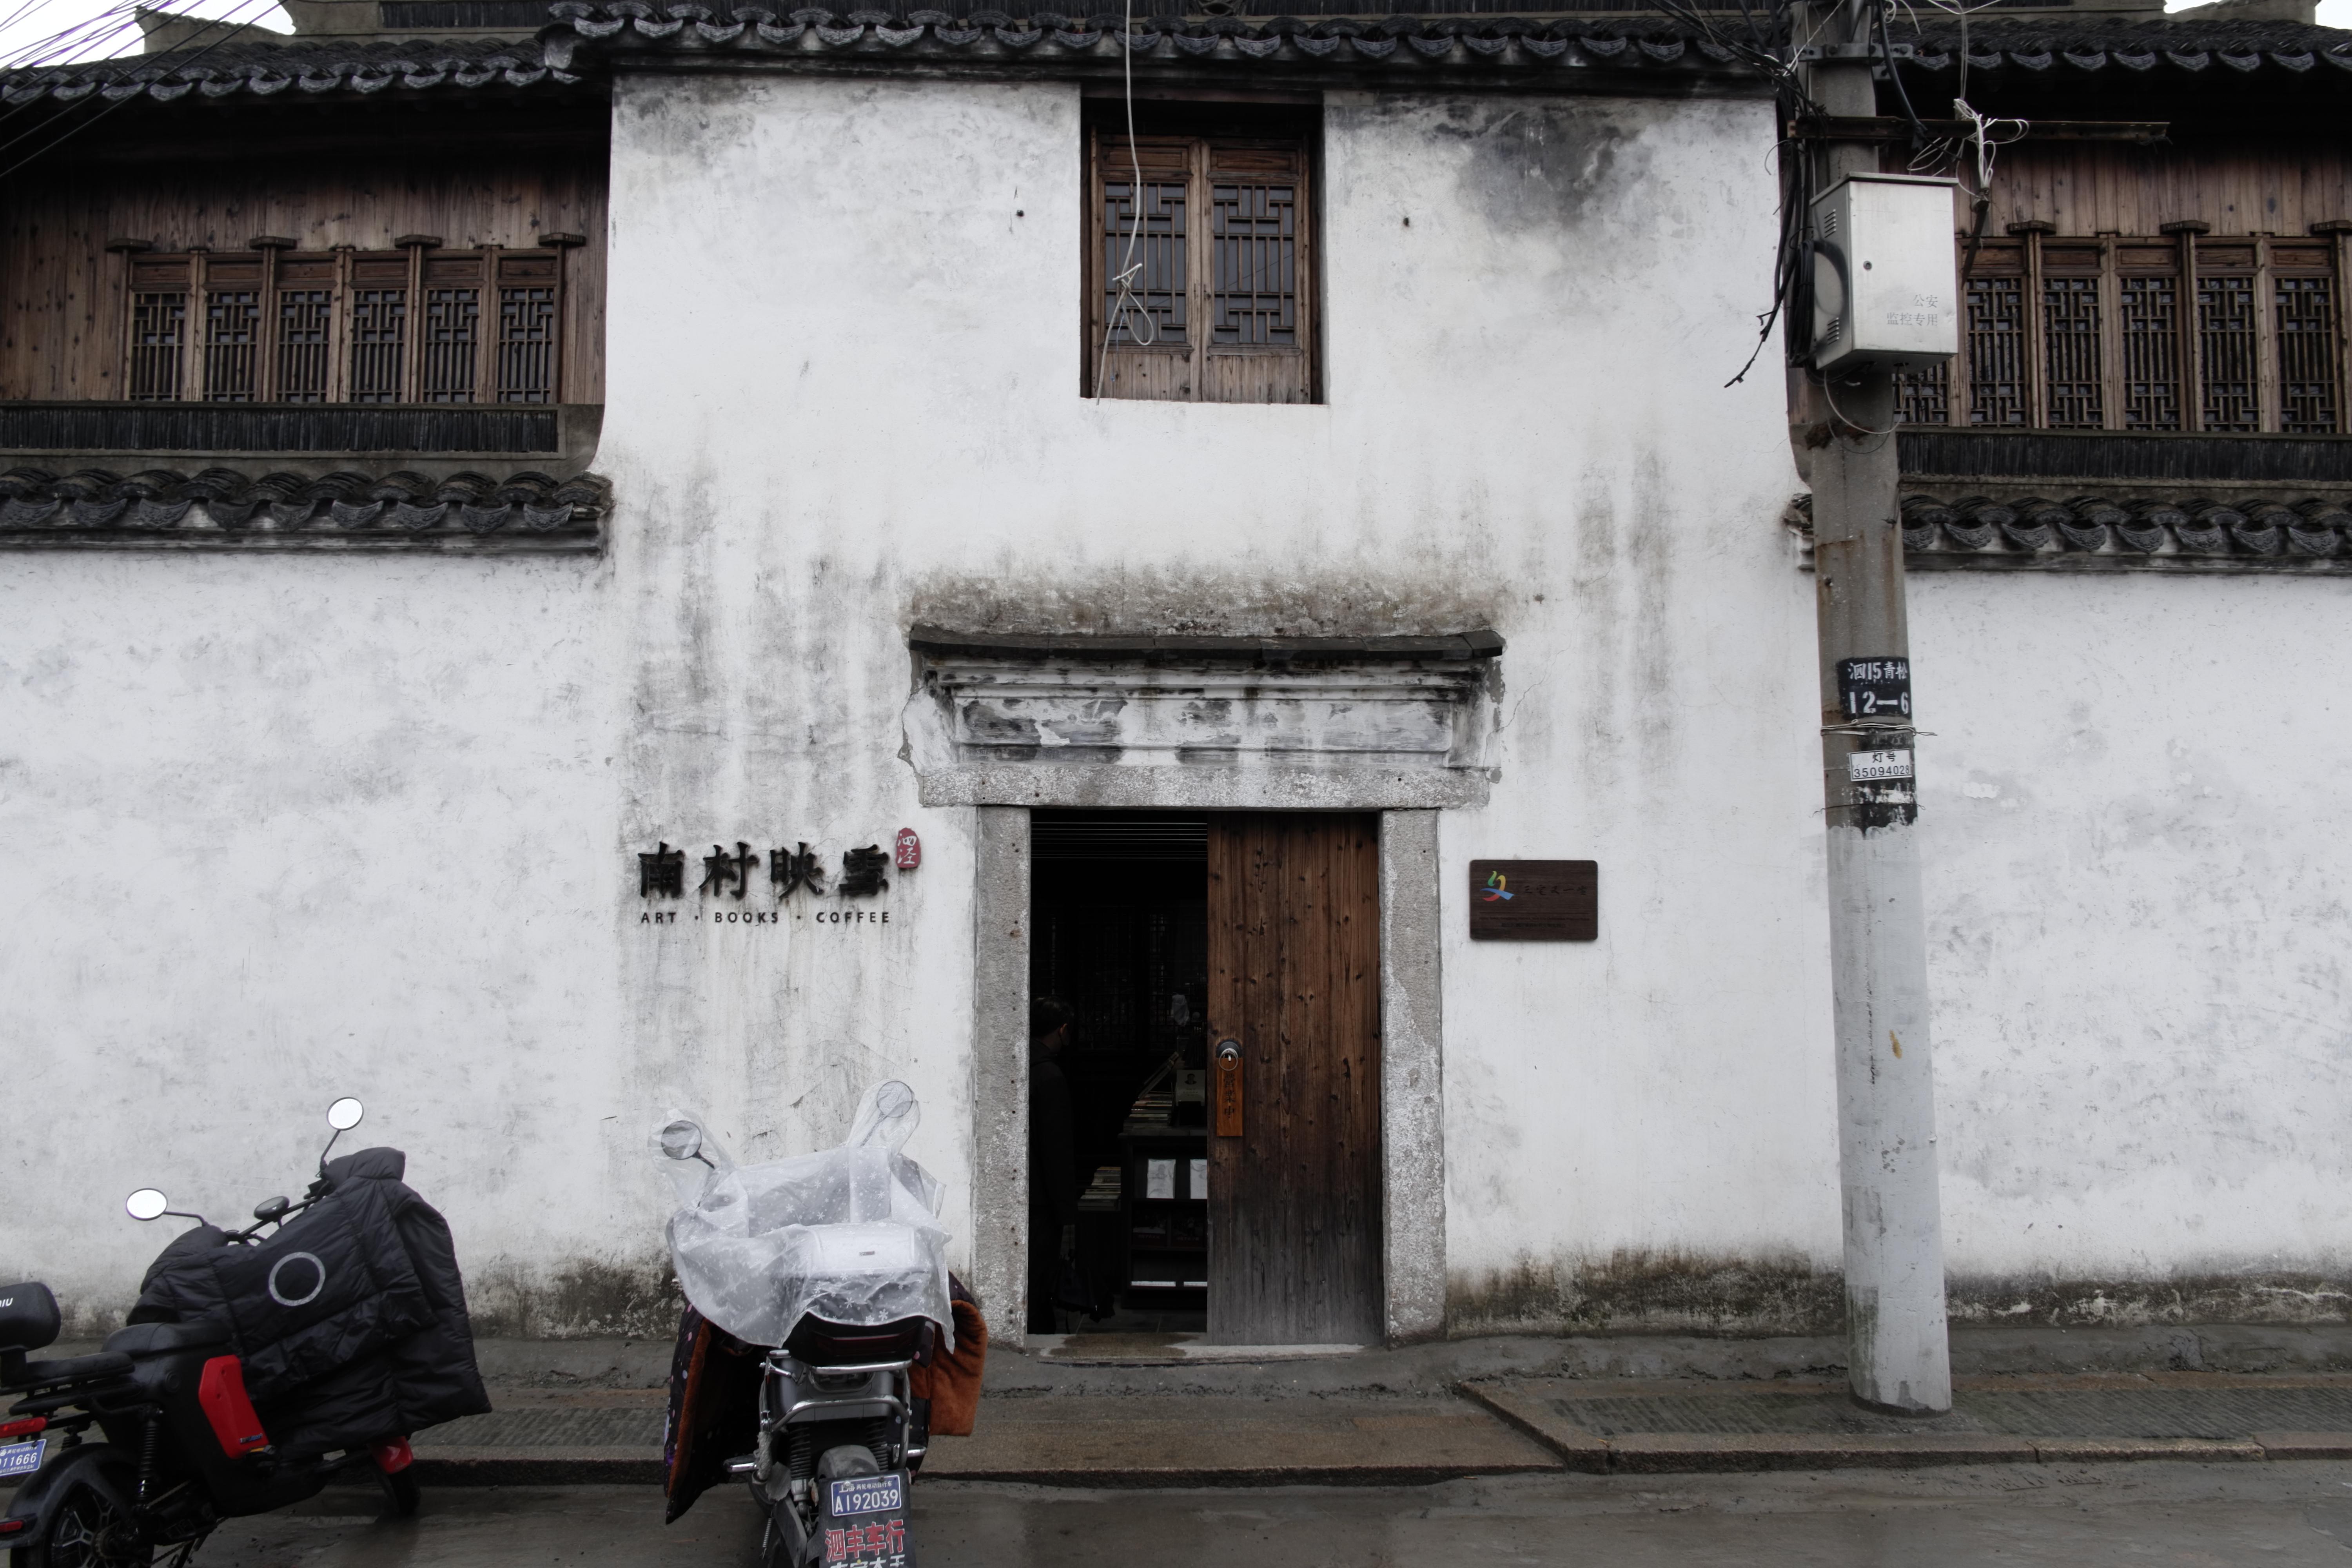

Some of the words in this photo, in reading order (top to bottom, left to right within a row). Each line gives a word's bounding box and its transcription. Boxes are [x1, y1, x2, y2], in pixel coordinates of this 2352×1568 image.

[1913, 294, 1938, 308] 公安
[1887, 313, 1938, 326] 监控专用
[1847, 661, 1908, 680] 泗15青松
[1872, 752, 1896, 763] 灯号
[1854, 765, 1910, 778] 35094028
[897, 833, 917, 864] 泗泾
[641, 912, 677, 923] ART
[715, 912, 779, 923] BOOKS
[817, 911, 890, 924] COFFEE
[835, 1489, 898, 1513] A192039
[825, 1519, 905, 1562] 泗丰车行
